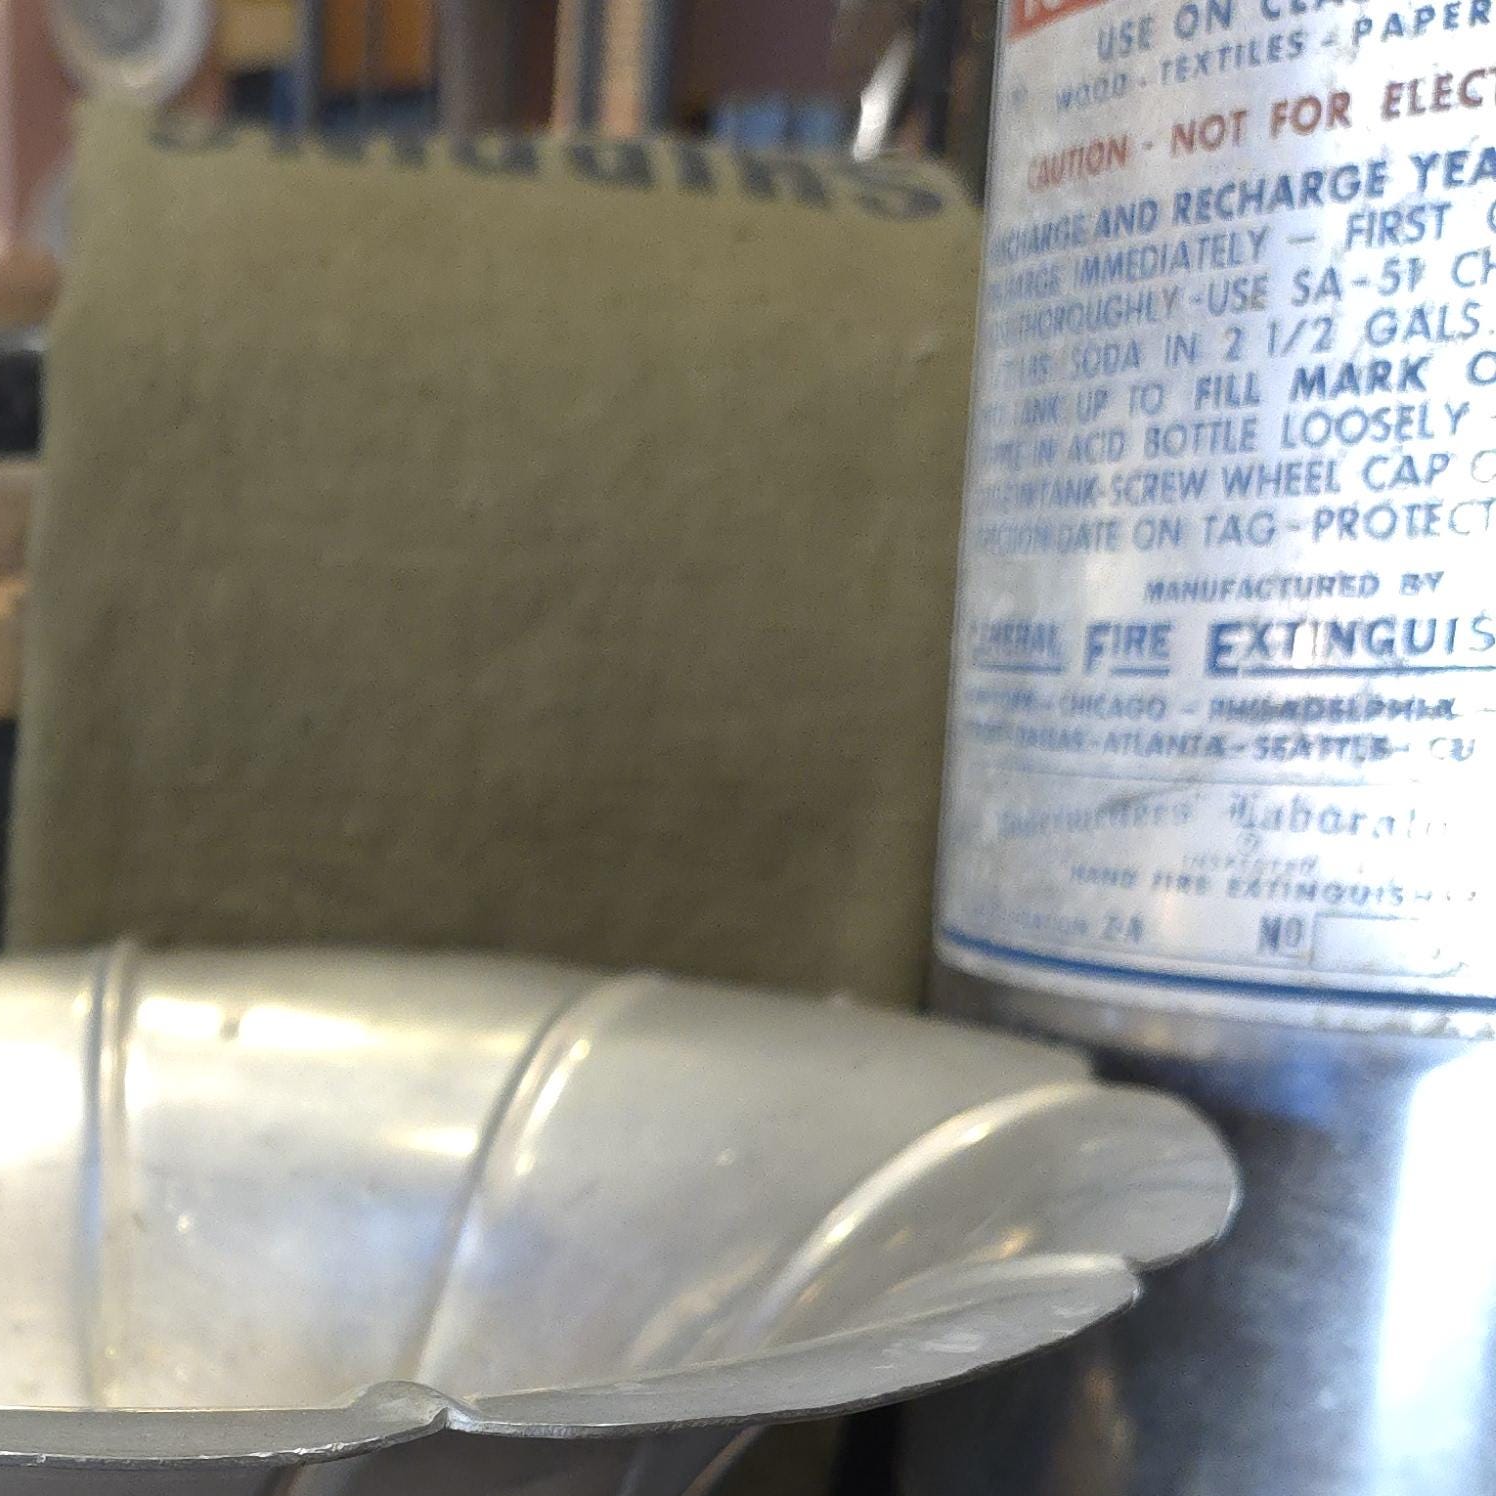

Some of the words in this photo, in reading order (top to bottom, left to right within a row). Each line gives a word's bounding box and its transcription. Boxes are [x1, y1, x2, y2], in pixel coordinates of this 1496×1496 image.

[1056, 73, 1128, 112] WOOD
[1159, 30, 1305, 86] TEXTILES
[1352, 0, 1492, 48] PAPER
[1098, 12, 1153, 62] USE
[1172, 0, 1233, 40] ON
[1027, 133, 1129, 193] CAUTION
[1170, 108, 1247, 158] NOT
[1269, 90, 1352, 139] FOR
[1094, 195, 1159, 240] AND
[1169, 160, 1387, 226] RECHARGE
[1074, 226, 1269, 289] IMMEDIATELY
[1345, 200, 1451, 252] FIRST
[1070, 338, 1141, 380] SODA
[1165, 333, 1198, 370] IN
[1224, 326, 1244, 362] 2
[1268, 316, 1333, 356] 1/2
[1076, 388, 1110, 424] UP
[1130, 383, 1165, 418] TO
[1194, 372, 1260, 411] FILL
[1289, 351, 1433, 403] MARK
[1069, 427, 1126, 466] ACID
[1144, 416, 1257, 462] BOTTLE
[1281, 400, 1470, 450] LOOSELY
[1111, 468, 1207, 506] SCREW
[1221, 458, 1341, 498] WHEEL
[1361, 453, 1451, 492] CAP
[1133, 513, 1184, 552] ON
[1204, 508, 1276, 548] TAG
[1144, 570, 1381, 603] MANUFACTURED
[1400, 570, 1445, 597] BY
[1084, 616, 1172, 676] FIRE
[1206, 612, 1496, 680] EXTINGUIS
[1060, 691, 1168, 722] CHICAGO
